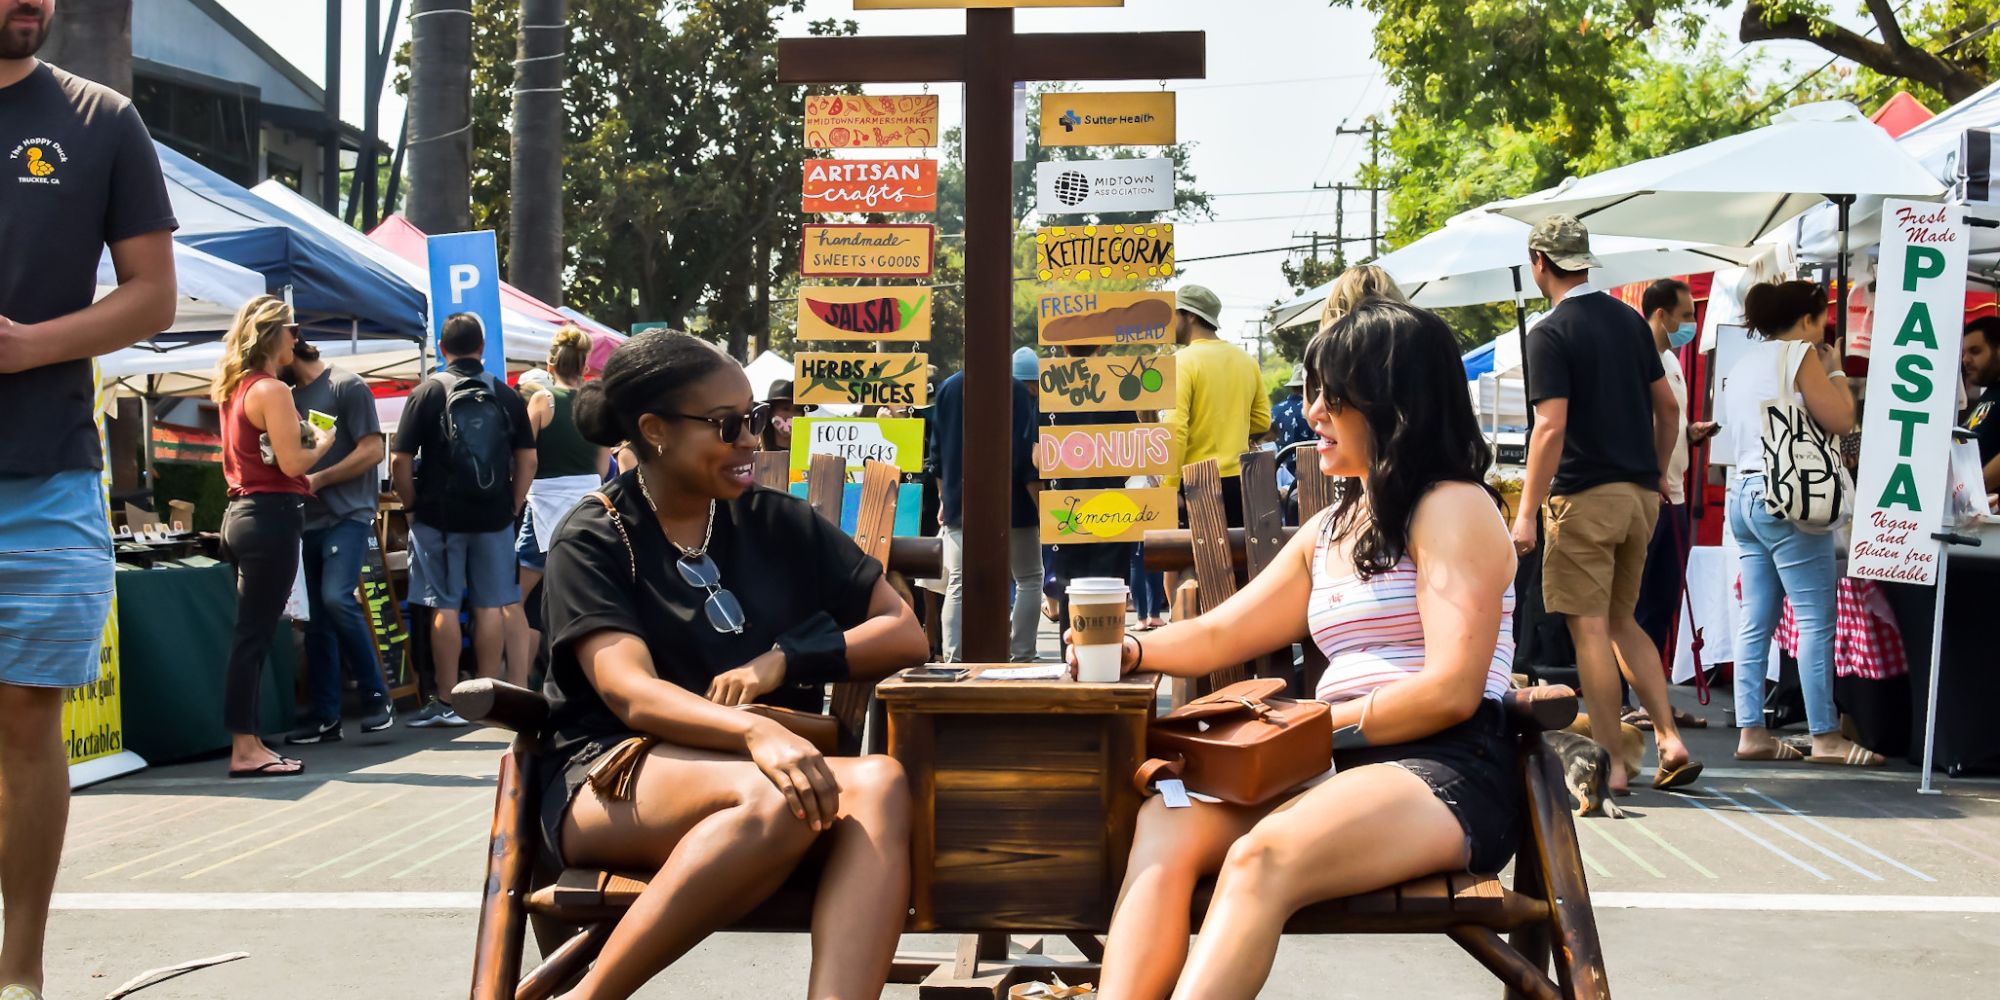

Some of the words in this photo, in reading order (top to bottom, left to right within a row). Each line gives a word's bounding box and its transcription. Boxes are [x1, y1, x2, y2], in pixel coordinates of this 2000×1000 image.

[807, 116, 936, 125] #MIDTOWNFARMERSMARKET
[1084, 115, 1118, 125] Sutter
[1120, 113, 1155, 124] Health
[10, 145, 23, 160] The
[22, 137, 53, 147] Hoppy
[52, 142, 68, 163] Duck
[808, 163, 920, 182] ARTISAN
[1094, 175, 1154, 187] MIDTOWN
[820, 184, 908, 207] crafts
[1094, 187, 1155, 196] ASSOCIATION
[1895, 206, 1947, 228] Fresh
[813, 229, 911, 247] handmade
[1905, 227, 1957, 244] Made
[813, 253, 867, 267] SWEETS
[877, 255, 921, 268] GOODS
[824, 298, 895, 333] SALSA
[1041, 294, 1097, 319] FRESH
[1114, 321, 1167, 343] BREAD
[801, 359, 865, 380] HERBS
[1040, 358, 1092, 397] OLIVE
[1876, 245, 1946, 512] PASTA
[847, 382, 915, 404] SPICES
[817, 425, 860, 443] FOOD
[837, 443, 895, 464] TRUCKS
[1040, 427, 1172, 472] DONUTS
[1057, 496, 1160, 535] Lemonade
[1870, 511, 1918, 533] Vegan
[1875, 531, 1909, 546] and
[1854, 541, 1900, 560] Gluten
[1904, 548, 1934, 566] free
[1856, 565, 1930, 583] available
